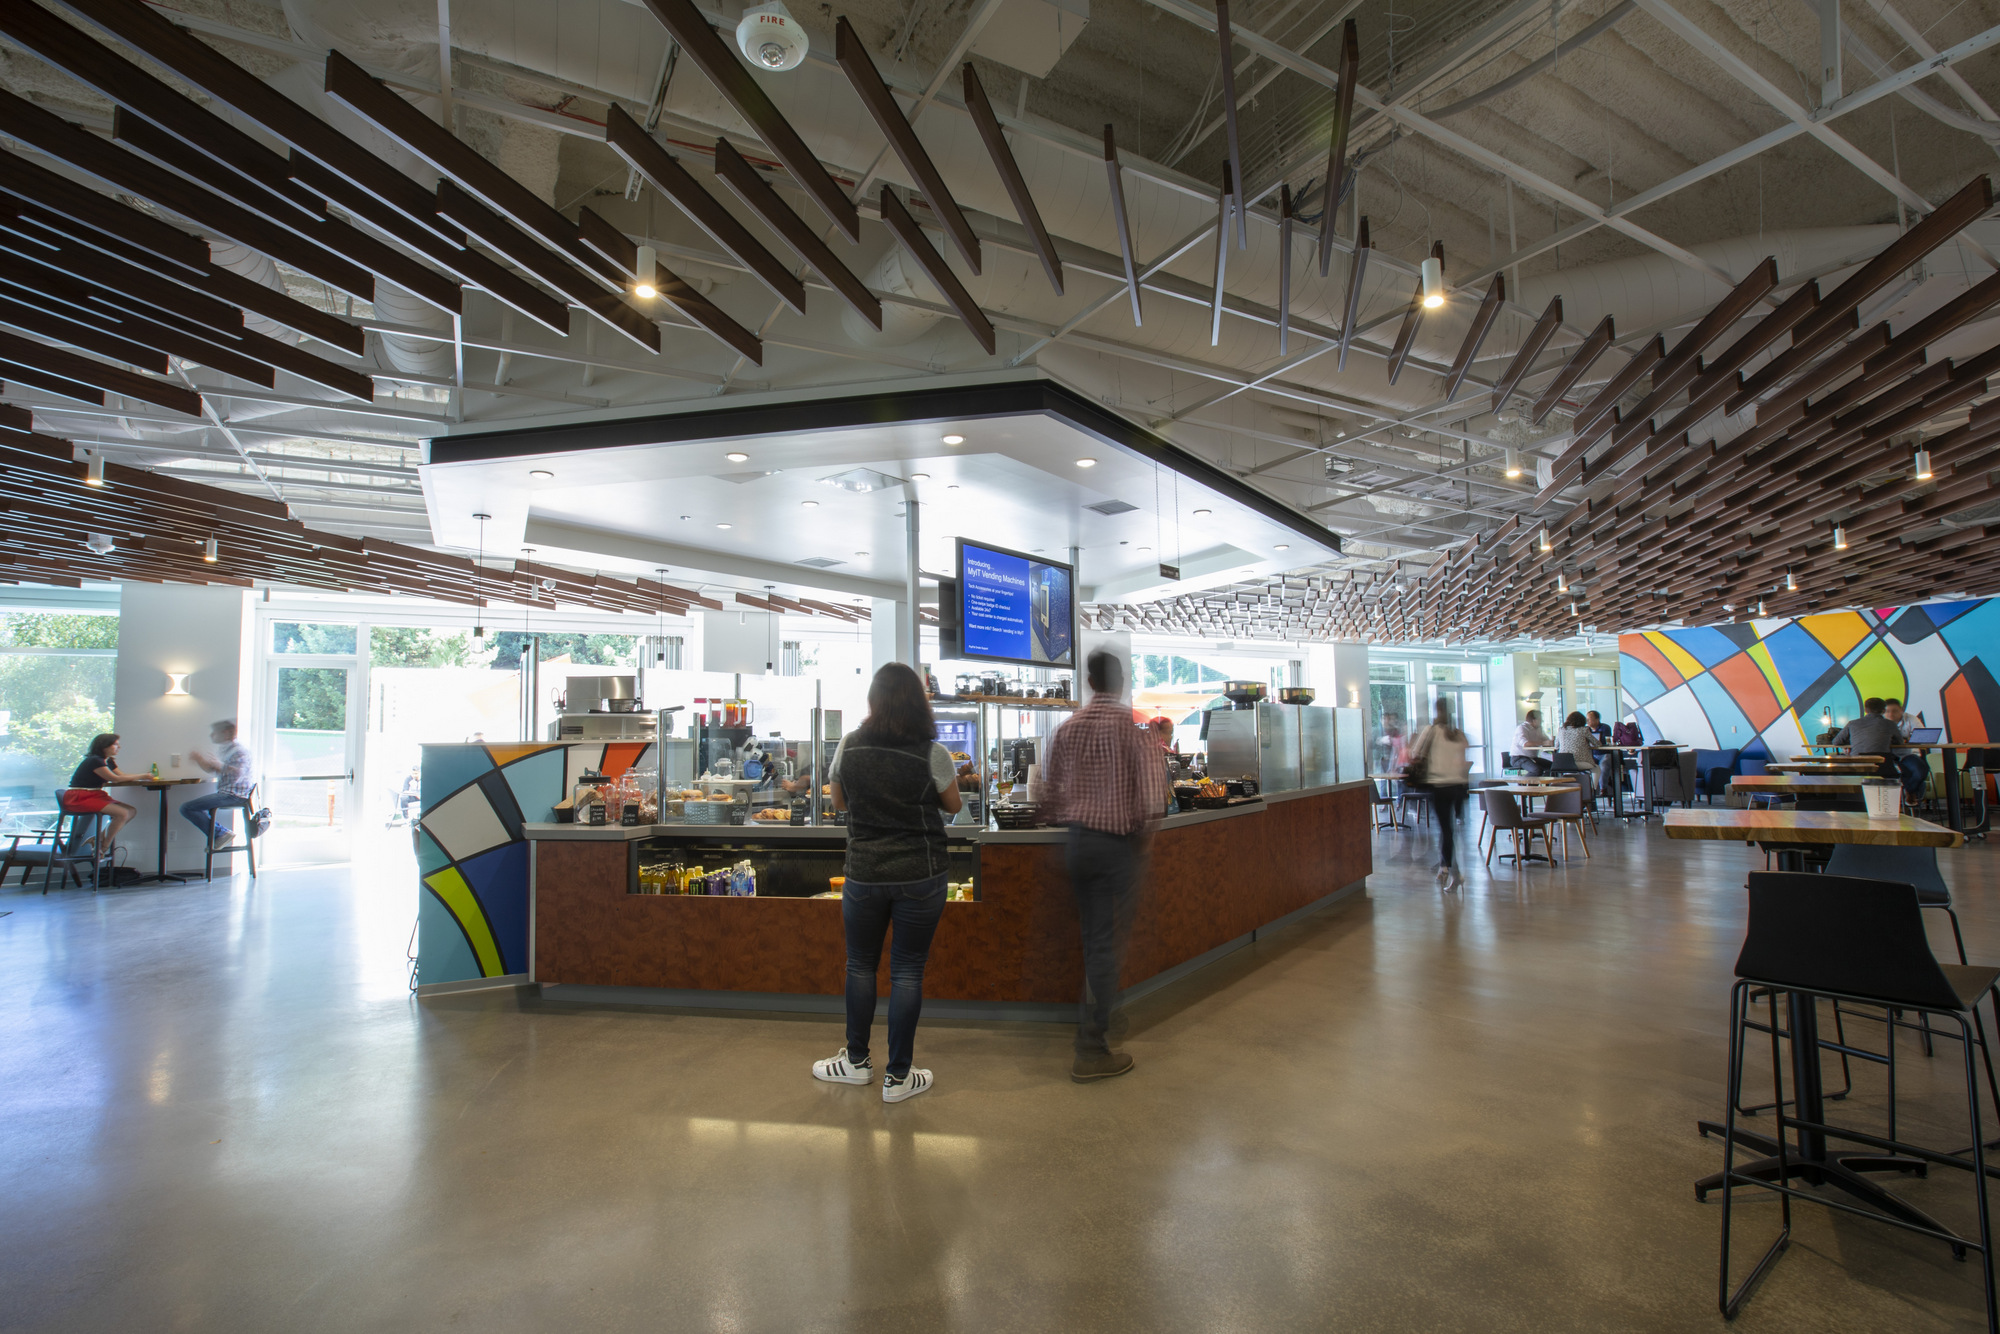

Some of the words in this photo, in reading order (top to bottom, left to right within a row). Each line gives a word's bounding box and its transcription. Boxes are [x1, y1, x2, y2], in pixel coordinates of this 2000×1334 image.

[760, 16, 784, 26] FIRE
[968, 558, 994, 570] Introducing...
[968, 567, 981, 577] MyIT
[982, 570, 1002, 582] Vending
[1002, 574, 1025, 586] Machines
